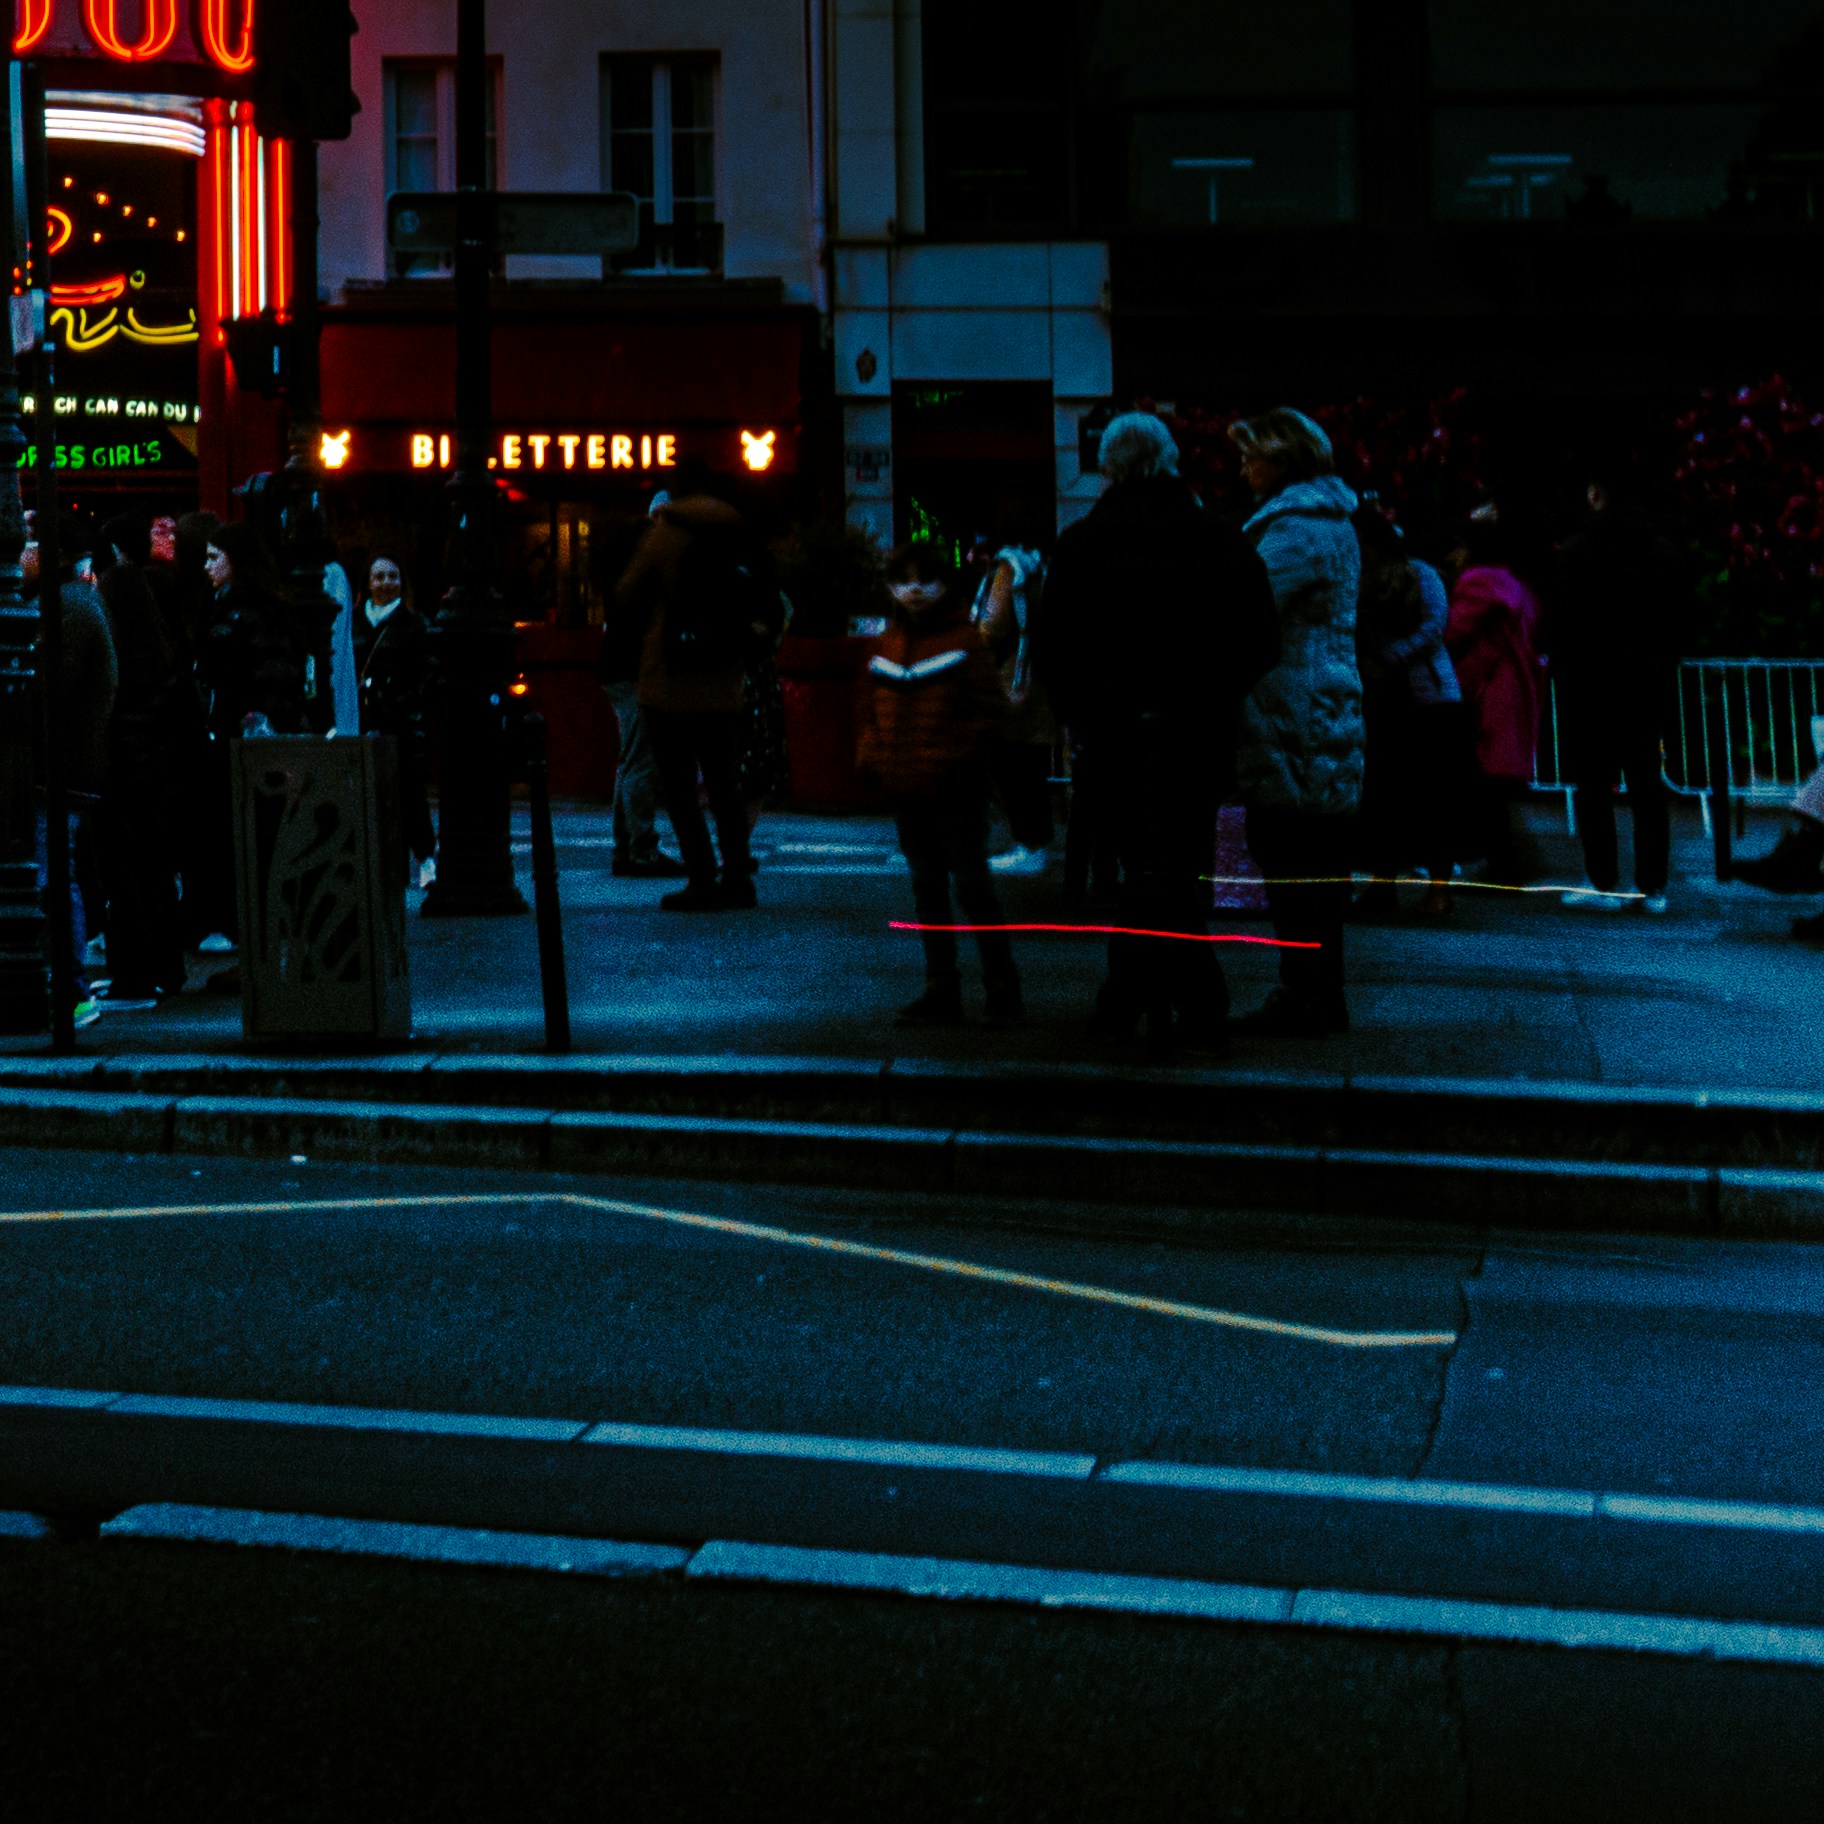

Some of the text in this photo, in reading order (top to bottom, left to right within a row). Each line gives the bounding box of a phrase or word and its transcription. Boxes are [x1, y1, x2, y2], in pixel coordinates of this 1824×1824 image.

[84, 396, 119, 416] CAN
[125, 399, 159, 417] CAN
[163, 401, 187, 422] DU
[92, 439, 162, 468] GIRL'S
[411, 434, 677, 469] BIETTERIE
